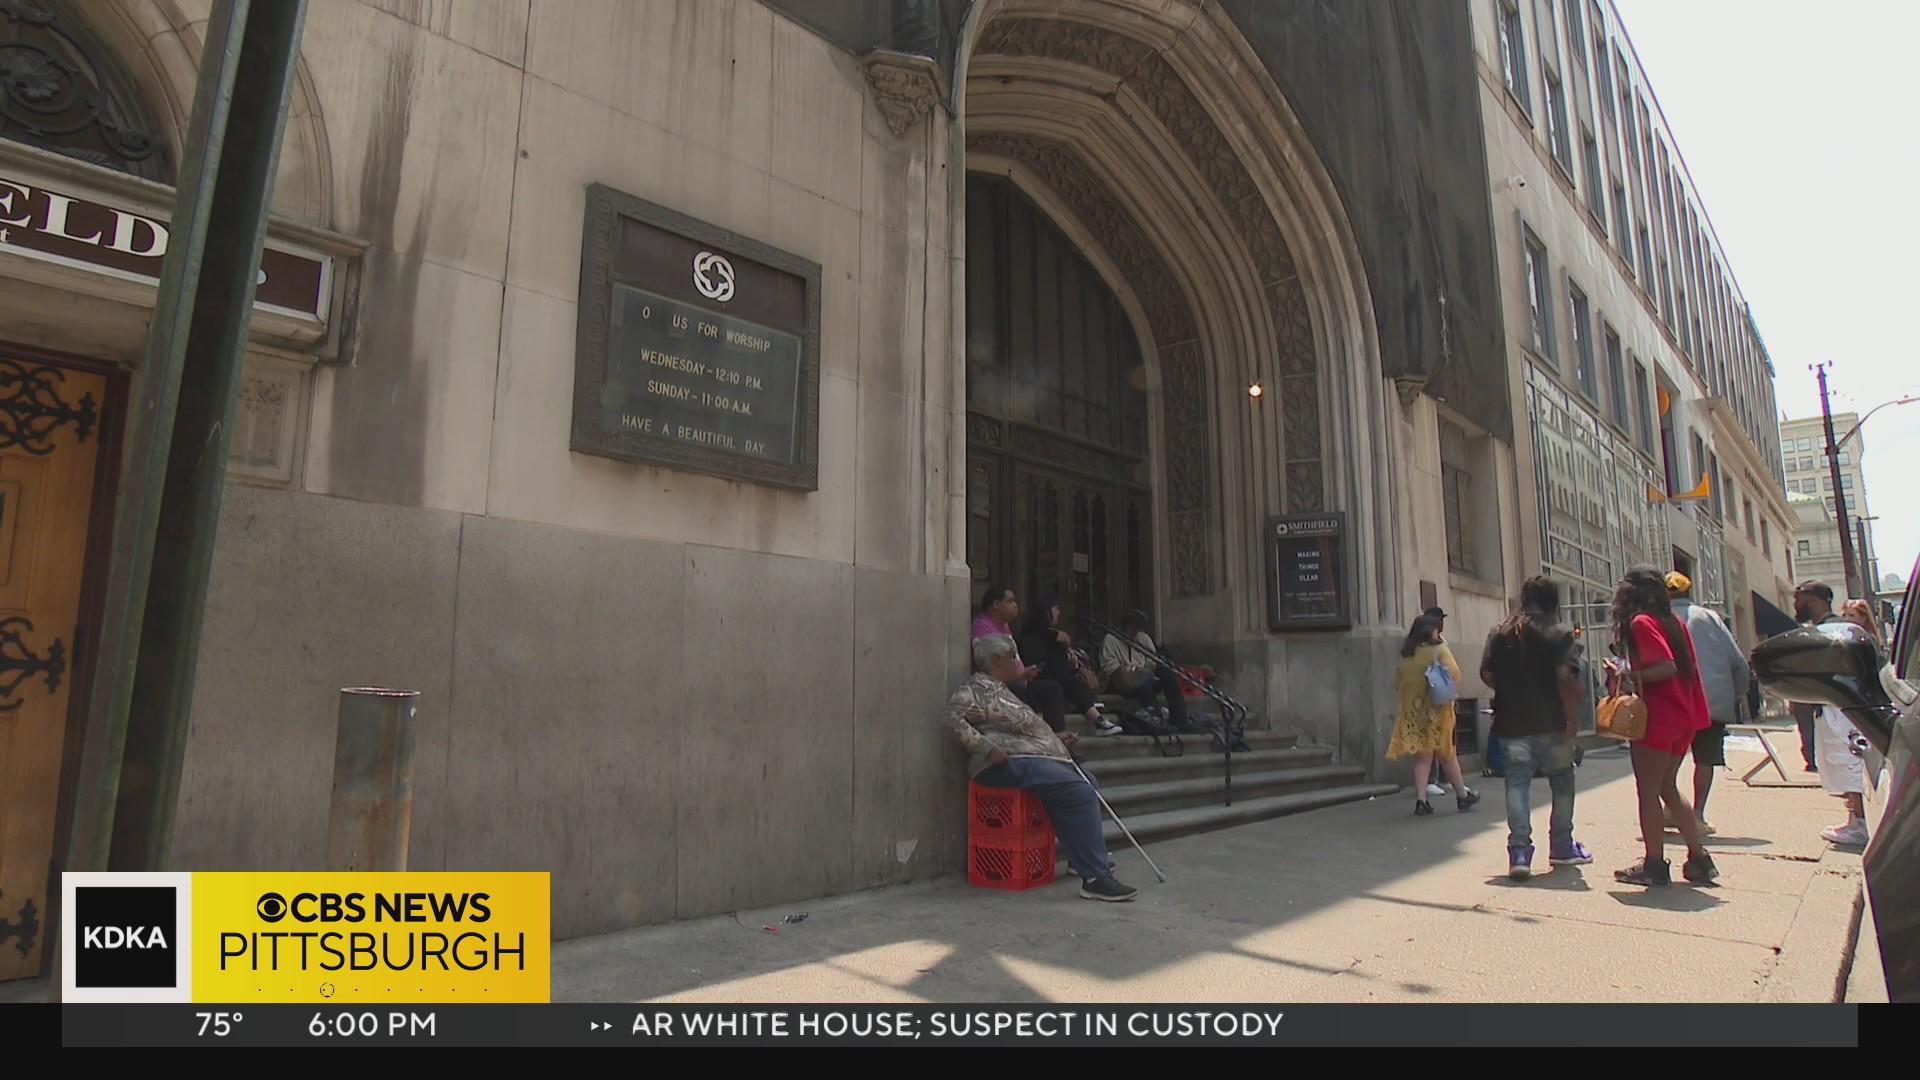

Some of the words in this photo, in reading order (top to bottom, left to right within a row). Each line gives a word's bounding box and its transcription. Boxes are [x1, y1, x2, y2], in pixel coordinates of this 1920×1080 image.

[672, 314, 688, 329] US
[697, 321, 718, 338] FOR
[726, 329, 771, 352] WORSHIP
[745, 375, 763, 390] P.M.
[732, 401, 752, 415] A.M.
[622, 413, 652, 432] HAVE
[662, 423, 669, 436] A
[678, 425, 736, 449] BEAUTIFUL
[1299, 574, 1319, 582] CLEAR
